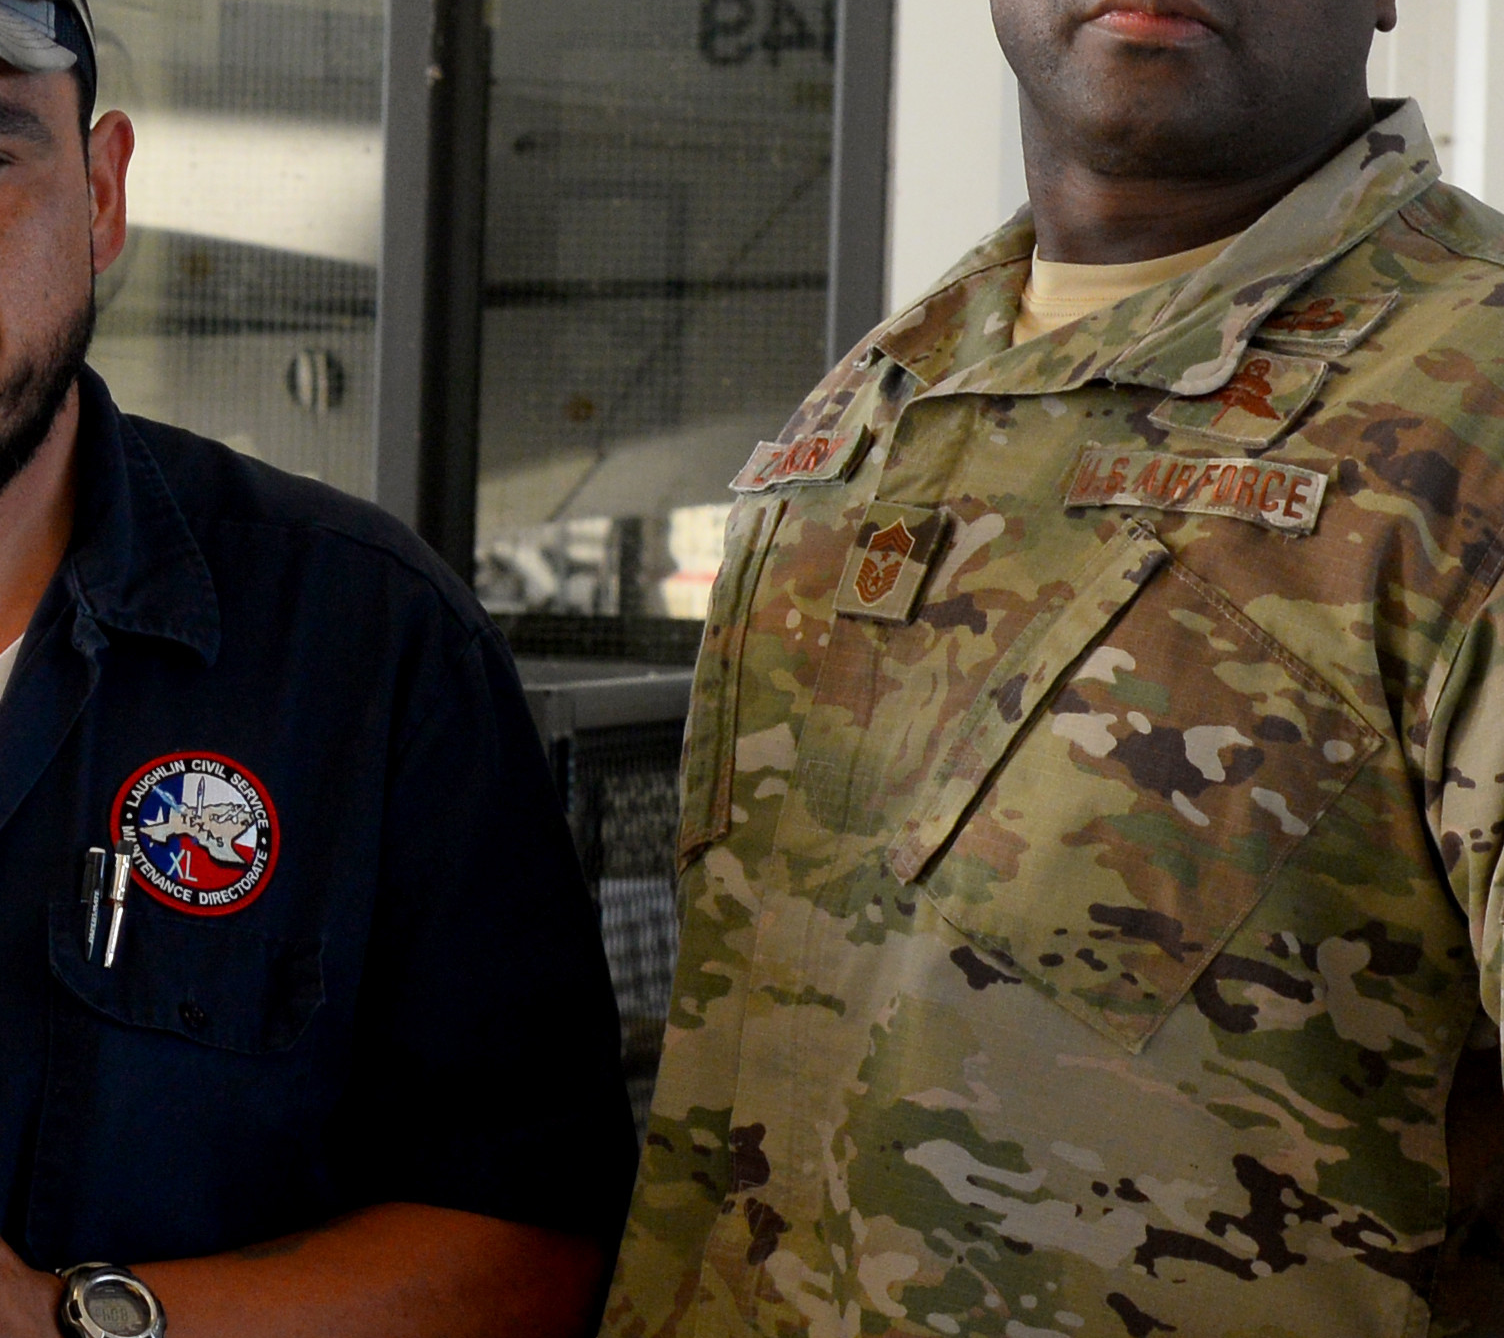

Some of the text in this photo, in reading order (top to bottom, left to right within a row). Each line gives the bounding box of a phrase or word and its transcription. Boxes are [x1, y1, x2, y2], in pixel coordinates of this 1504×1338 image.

[1131, 460, 1197, 501] AIR
[1194, 463, 1313, 519] FORCE
[126, 759, 269, 829] LAUGHLIN CIVIL SERVICE
[181, 813, 224, 847] TEXAS
[121, 825, 268, 905] MANTENANCE DIRECTORATE
[167, 849, 199, 882] XL
